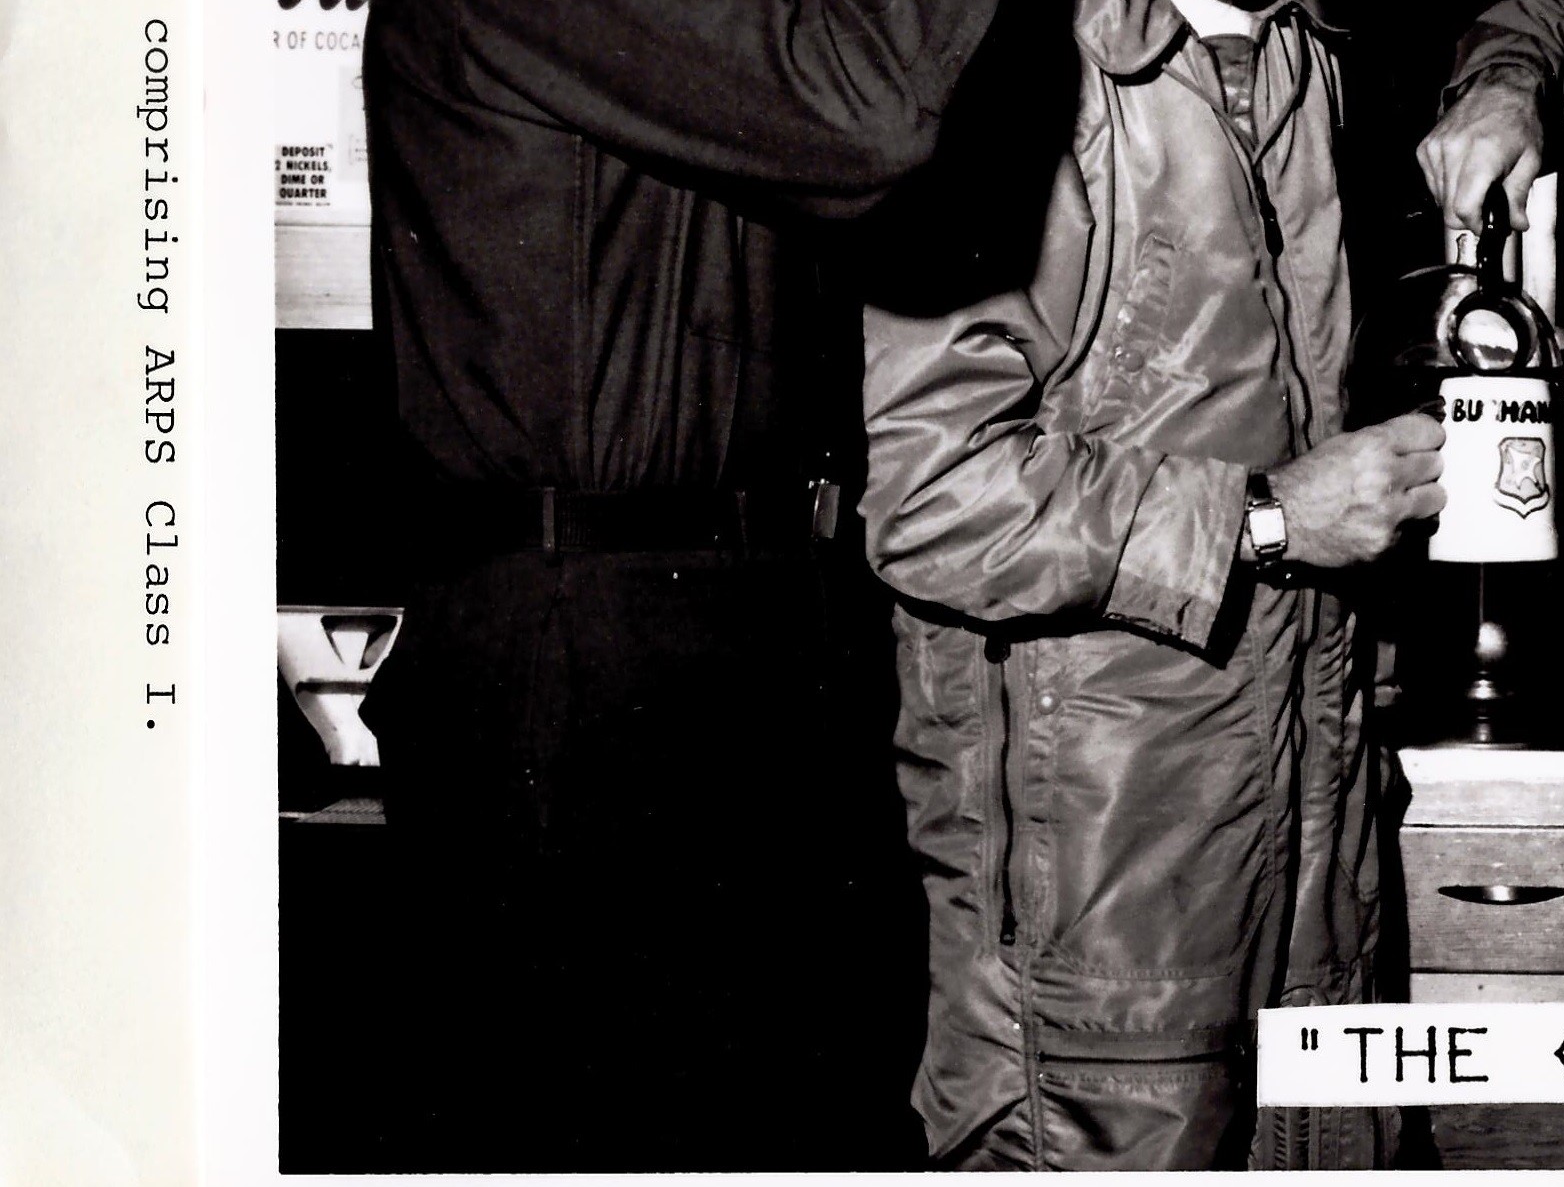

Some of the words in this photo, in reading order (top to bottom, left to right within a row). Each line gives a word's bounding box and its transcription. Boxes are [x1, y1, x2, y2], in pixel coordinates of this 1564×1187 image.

[287, 30, 307, 51] OF
[281, 146, 325, 157] DEPOSIT
[280, 174, 306, 185] DIME
[310, 174, 325, 185] OR
[279, 187, 327, 199] QUARTER
